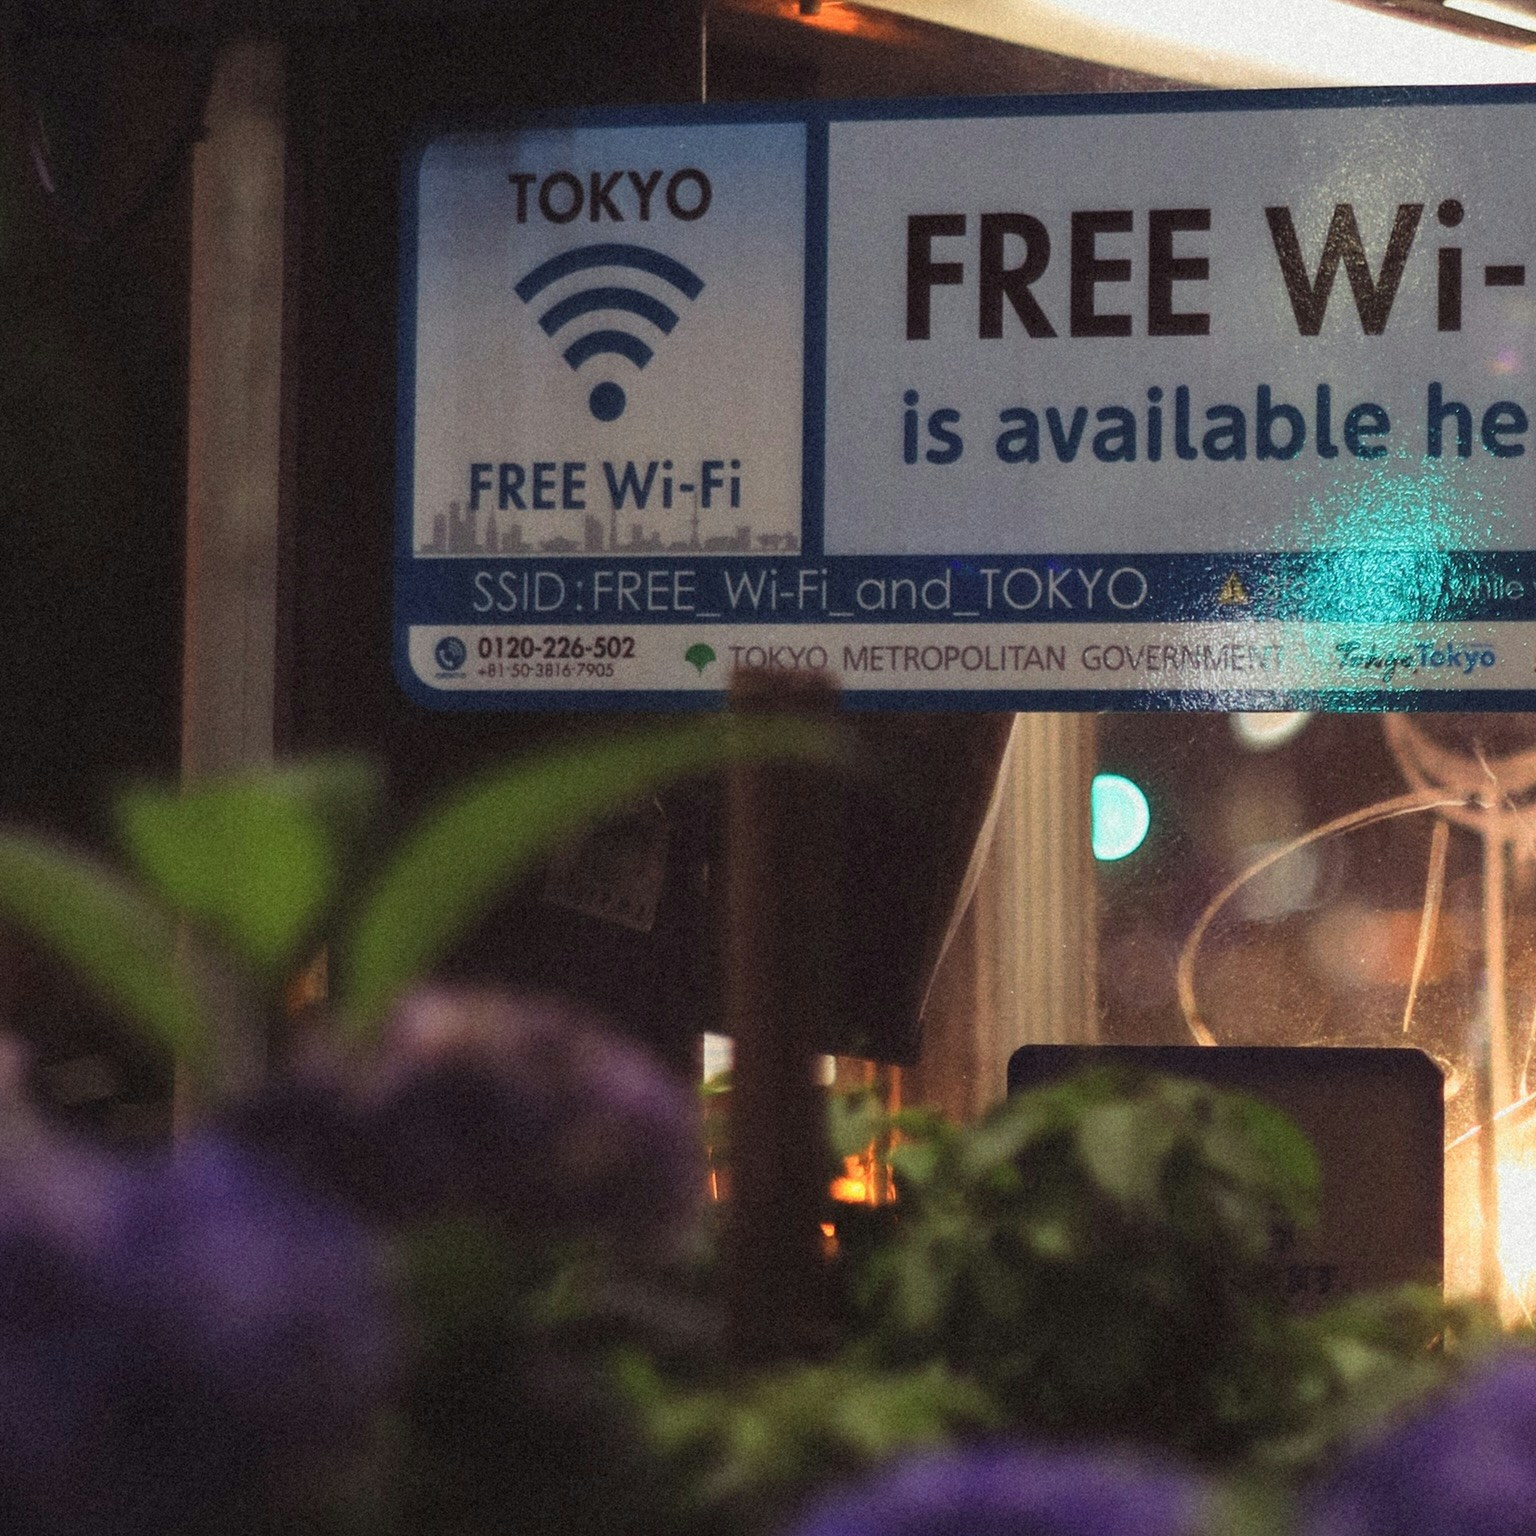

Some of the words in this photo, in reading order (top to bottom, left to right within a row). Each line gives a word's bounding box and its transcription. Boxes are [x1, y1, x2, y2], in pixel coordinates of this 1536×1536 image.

[508, 168, 712, 224] TOKYO
[904, 208, 1211, 341] FREE
[902, 389, 963, 465] is
[995, 383, 1391, 464] available
[469, 462, 586, 511] FREE
[603, 458, 741, 510] Wi-Fi
[477, 636, 636, 659] 0120-226-502
[728, 645, 829, 670] TOKYO
[842, 645, 1066, 672] METROPOLITAN
[1417, 640, 1496, 675] Tokyo
